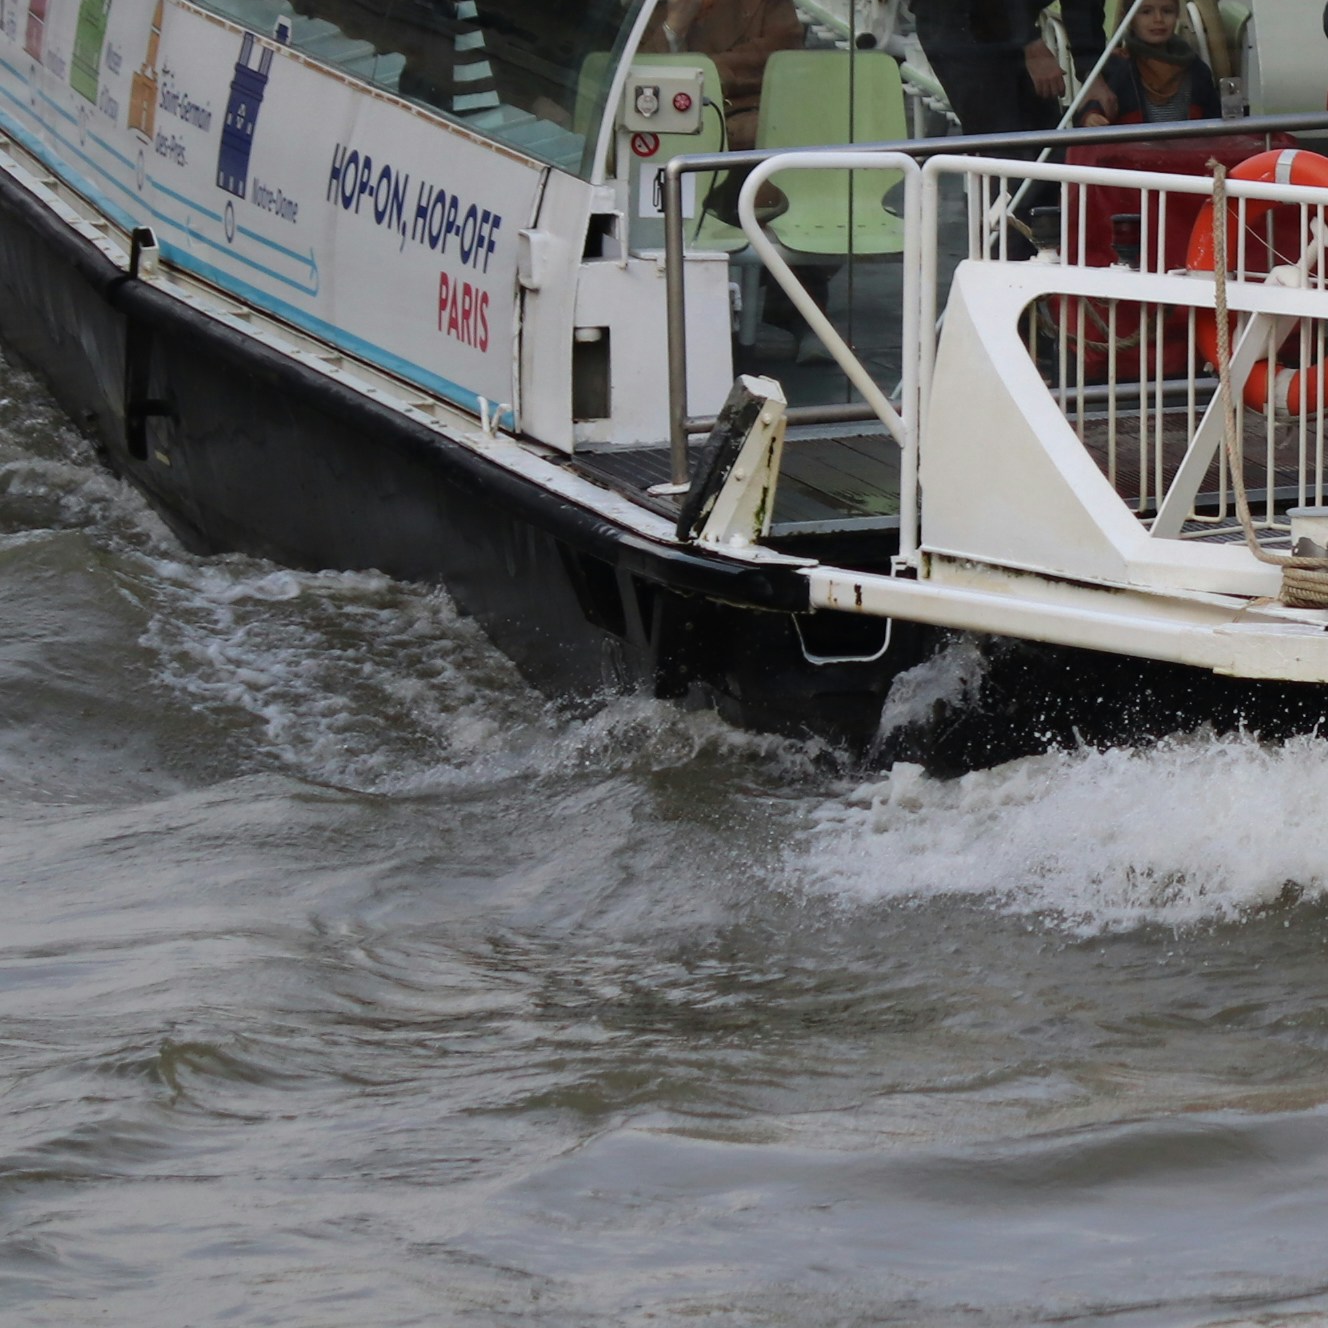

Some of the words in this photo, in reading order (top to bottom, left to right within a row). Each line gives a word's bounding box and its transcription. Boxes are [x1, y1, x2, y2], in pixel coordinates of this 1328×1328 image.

[326, 142, 410, 253] HOP-ON,
[411, 180, 502, 274] HOP-OFF
[437, 271, 490, 354] PARIS
